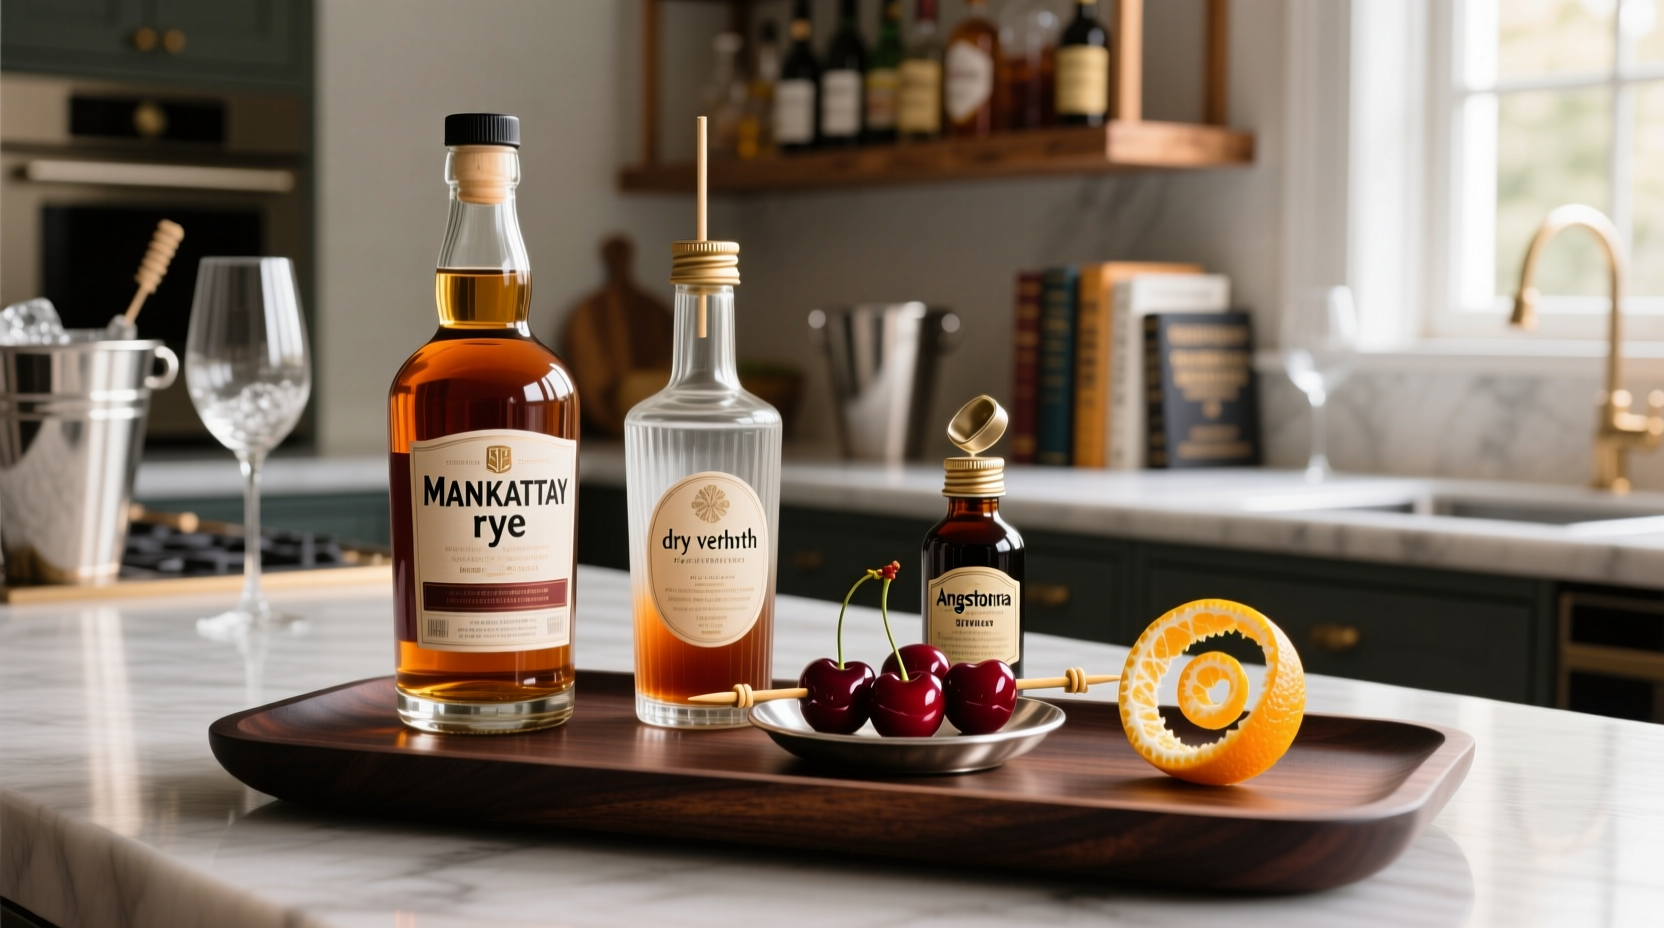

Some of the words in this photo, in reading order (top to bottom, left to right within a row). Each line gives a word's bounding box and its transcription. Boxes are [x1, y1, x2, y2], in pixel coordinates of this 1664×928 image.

[423, 475, 568, 507] MANKATTAY
[473, 513, 526, 548] rye
[662, 528, 691, 556] dry
